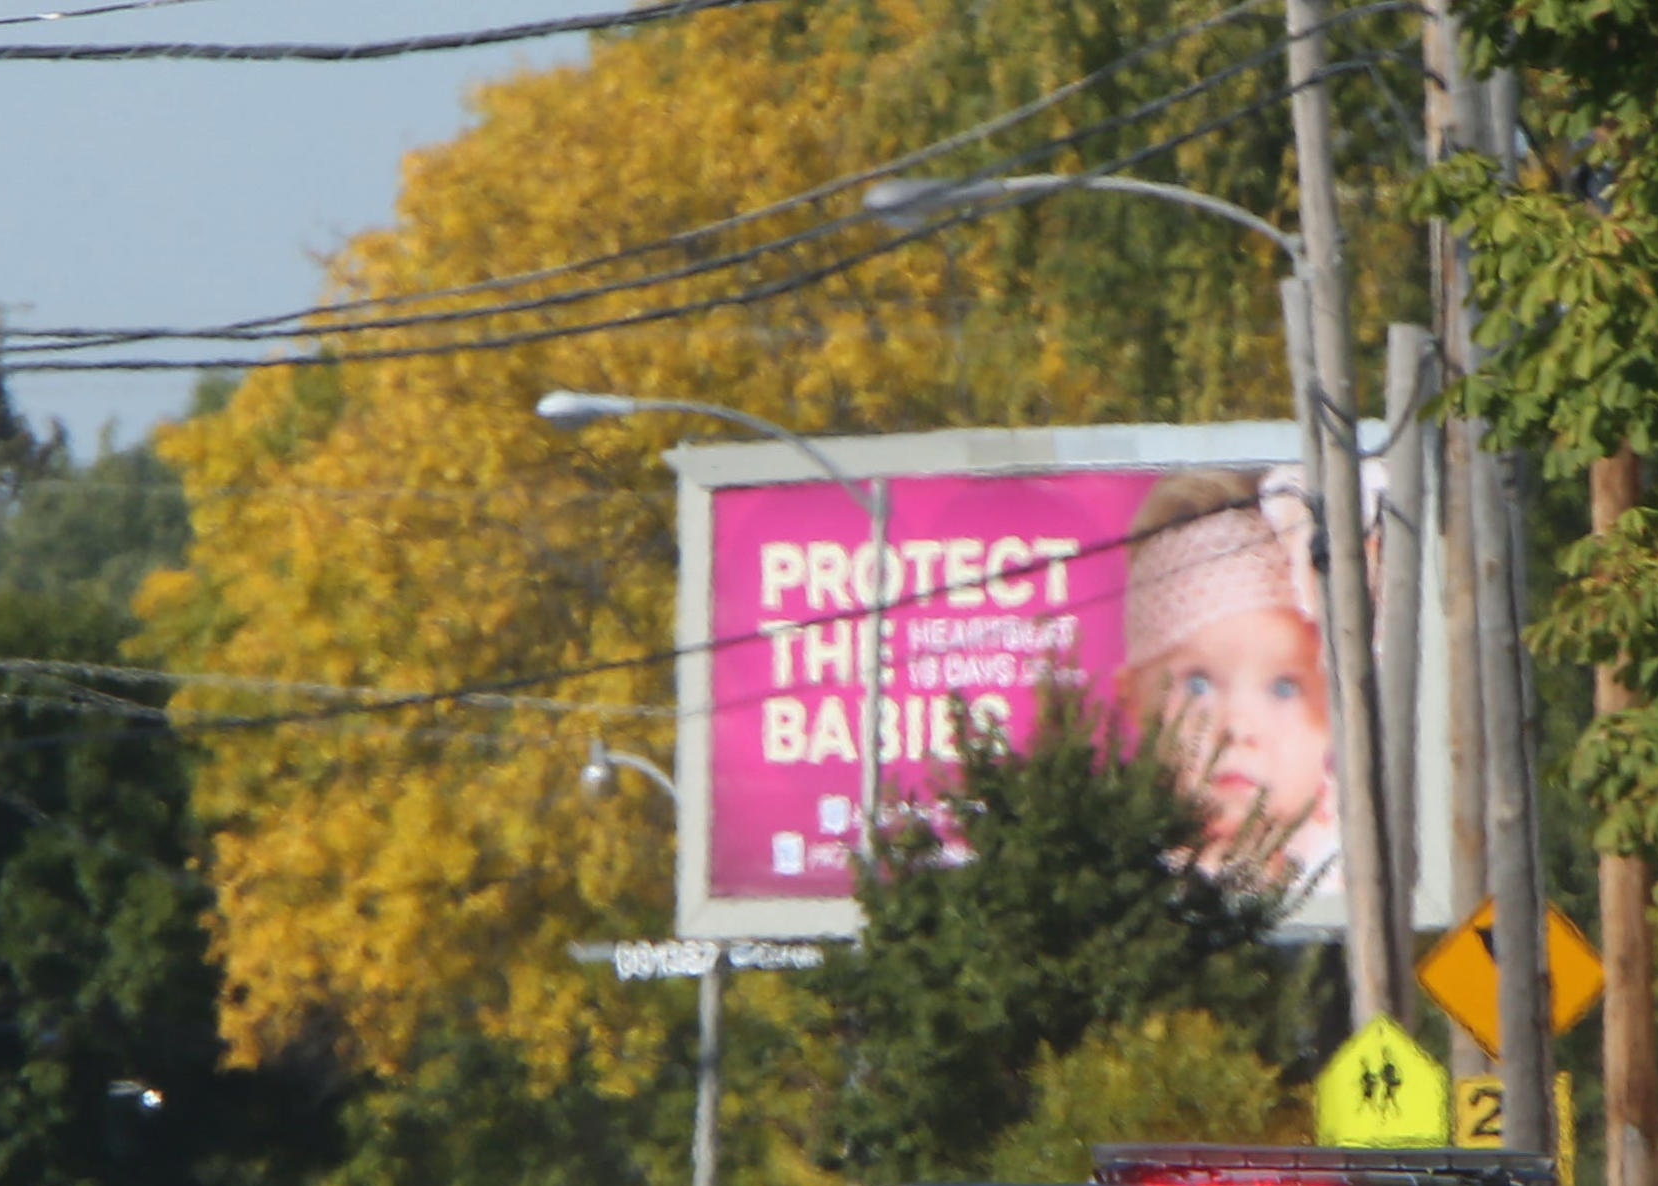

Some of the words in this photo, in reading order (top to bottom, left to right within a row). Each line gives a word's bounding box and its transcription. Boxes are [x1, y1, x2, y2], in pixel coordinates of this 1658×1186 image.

[759, 535, 1080, 611] PROTECT
[758, 617, 896, 688] THE
[761, 692, 1012, 763] BABIES
